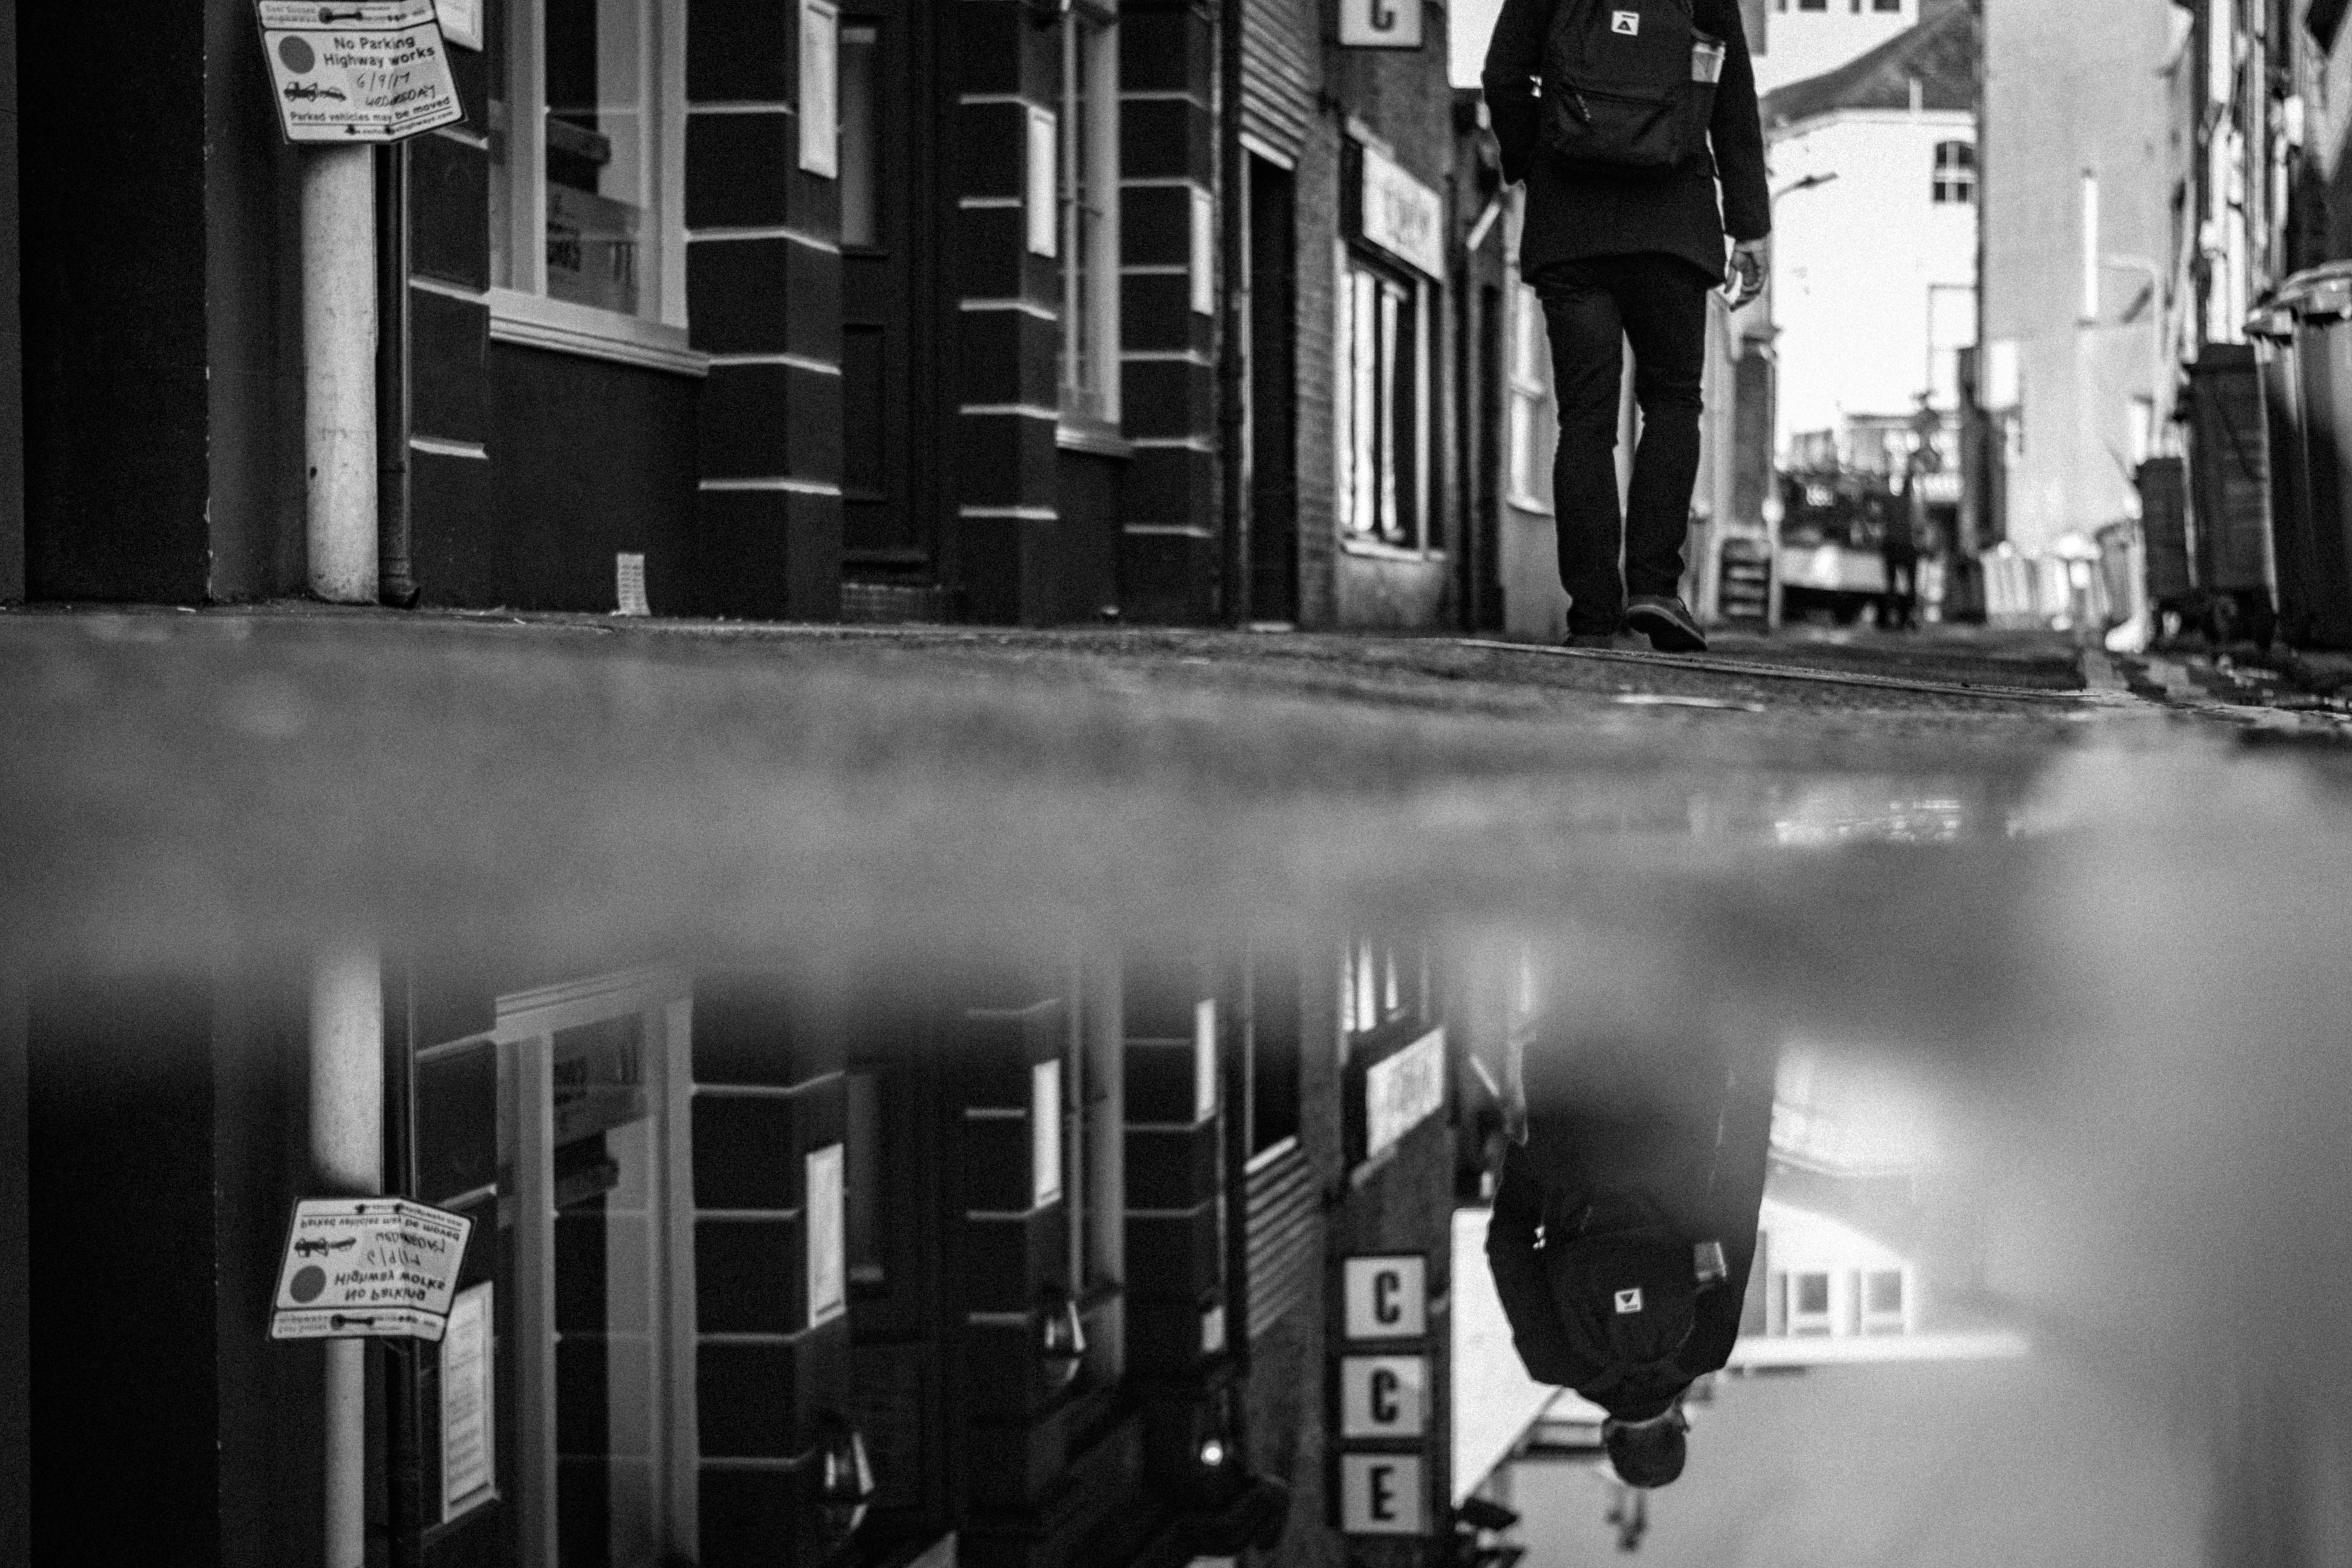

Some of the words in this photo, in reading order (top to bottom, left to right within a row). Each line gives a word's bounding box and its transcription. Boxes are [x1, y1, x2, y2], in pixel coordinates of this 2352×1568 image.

[334, 37, 356, 50] No
[359, 36, 415, 50] Parking
[324, 53, 383, 68] Highway
[389, 46, 435, 65] works
[290, 111, 325, 122] Parked
[330, 112, 369, 122] vehicles
[372, 113, 392, 124] may
[394, 110, 409, 120] be
[413, 96, 450, 113] moved
